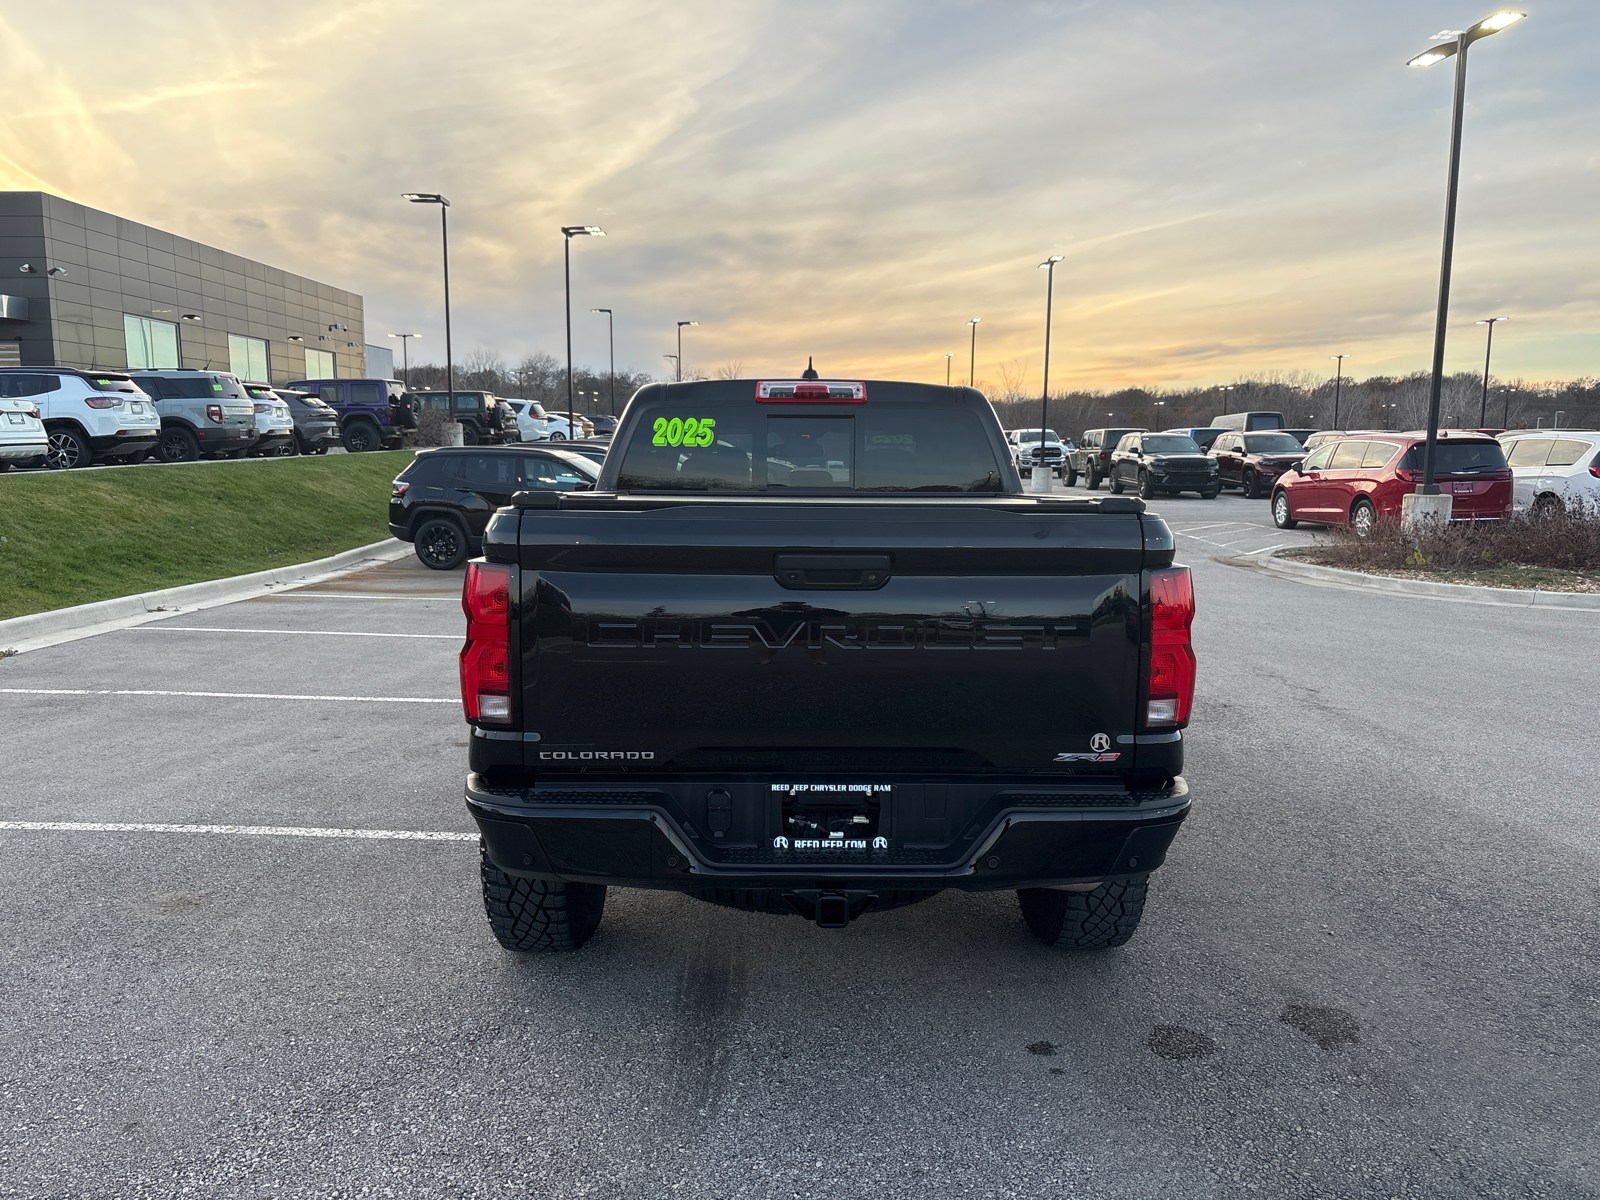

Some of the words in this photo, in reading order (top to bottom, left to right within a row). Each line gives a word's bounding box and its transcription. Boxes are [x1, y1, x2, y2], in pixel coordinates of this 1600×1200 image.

[652, 417, 716, 448] 2025
[586, 619, 1077, 649] CHEVROLET
[539, 751, 655, 760] COLORADO
[1052, 752, 1121, 762] ZR2
[792, 784, 809, 792] JEEP
[810, 784, 847, 792] CHRYSLER
[849, 784, 872, 792] DODGE
[873, 784, 891, 792] RAM
